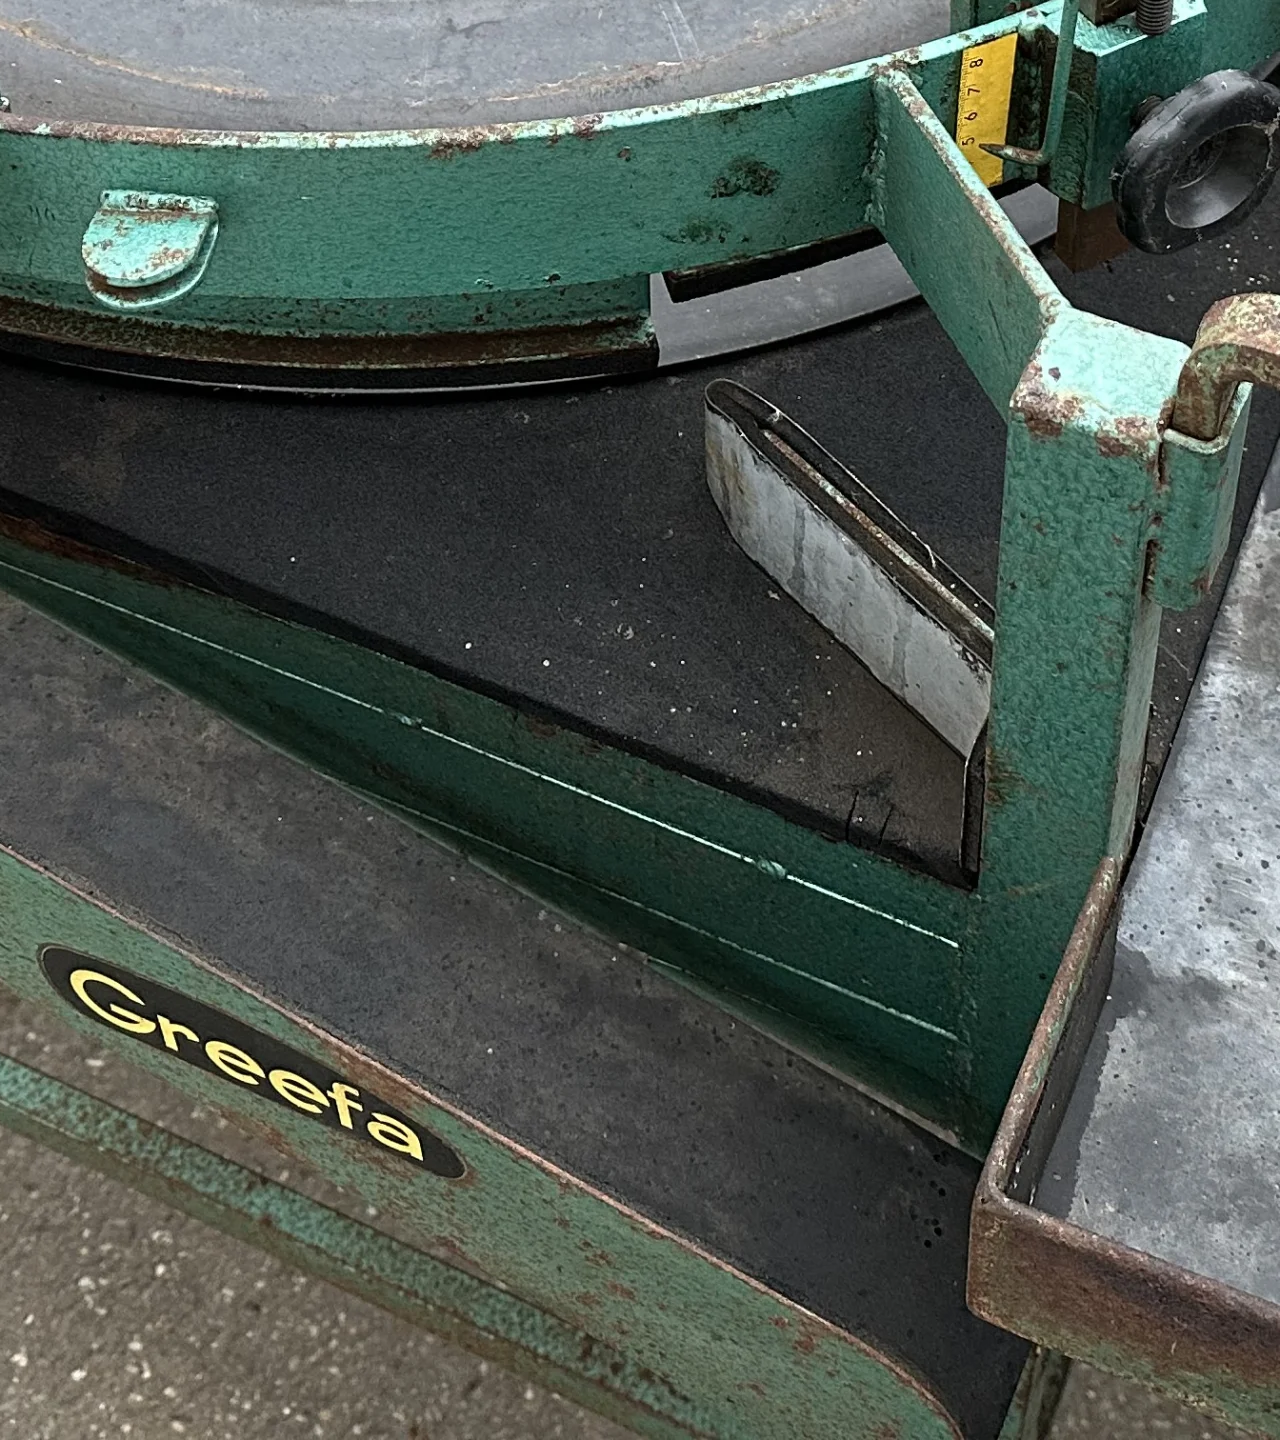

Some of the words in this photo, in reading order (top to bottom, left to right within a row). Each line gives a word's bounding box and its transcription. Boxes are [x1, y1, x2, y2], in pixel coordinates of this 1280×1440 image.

[969, 58, 984, 69] 8
[964, 111, 978, 121] 6
[69, 968, 424, 1161] Greefa
